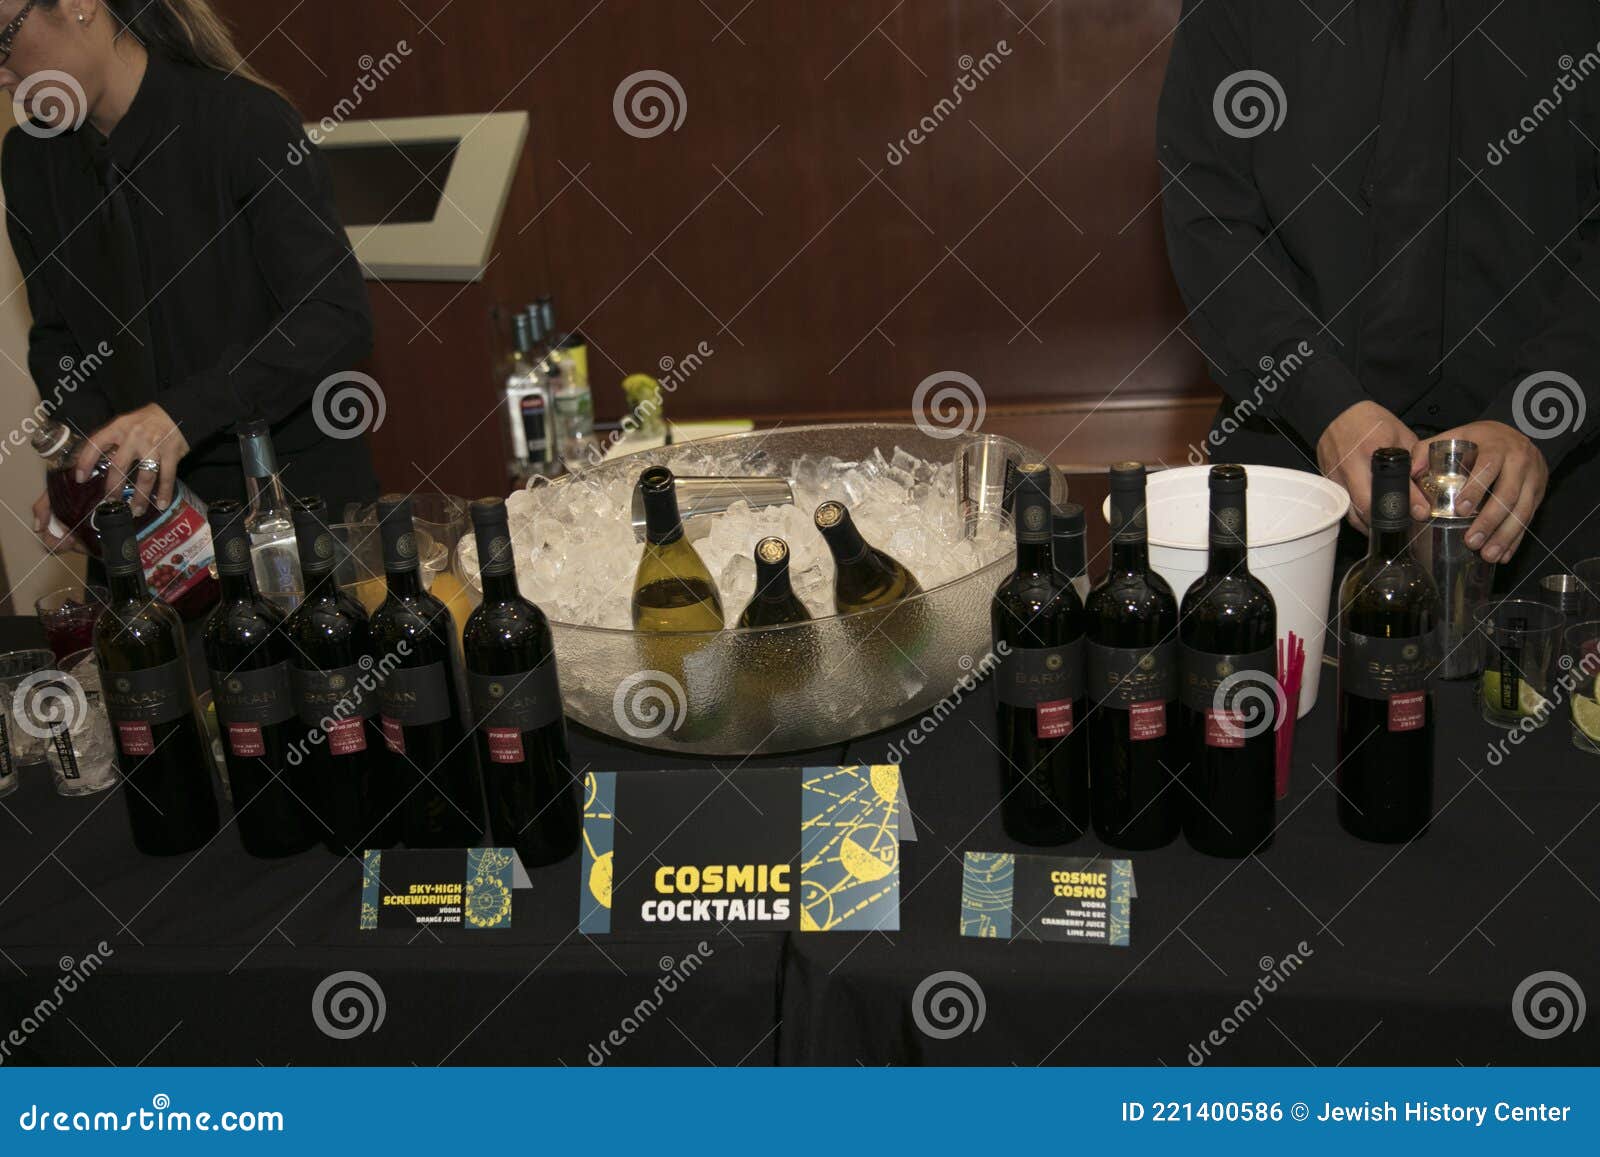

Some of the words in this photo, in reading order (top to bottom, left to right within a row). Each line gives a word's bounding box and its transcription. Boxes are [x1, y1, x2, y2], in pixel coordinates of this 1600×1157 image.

[140, 516, 194, 565] ranberry
[655, 864, 791, 894] COSMIC
[1050, 871, 1107, 886] COSMIC
[409, 884, 462, 894] SKY-HIGH
[1053, 885, 1107, 899] COSMO
[383, 895, 462, 905] SCREWDRIVER
[1081, 901, 1107, 909] VODKA
[641, 898, 791, 922] COCKTAILS
[1065, 909, 1091, 917] TRIPLE
[1041, 917, 1084, 927] CRANBERRY
[1085, 920, 1106, 928] JUICE
[1066, 929, 1084, 937] LIME
[1085, 930, 1106, 938] JUICE
